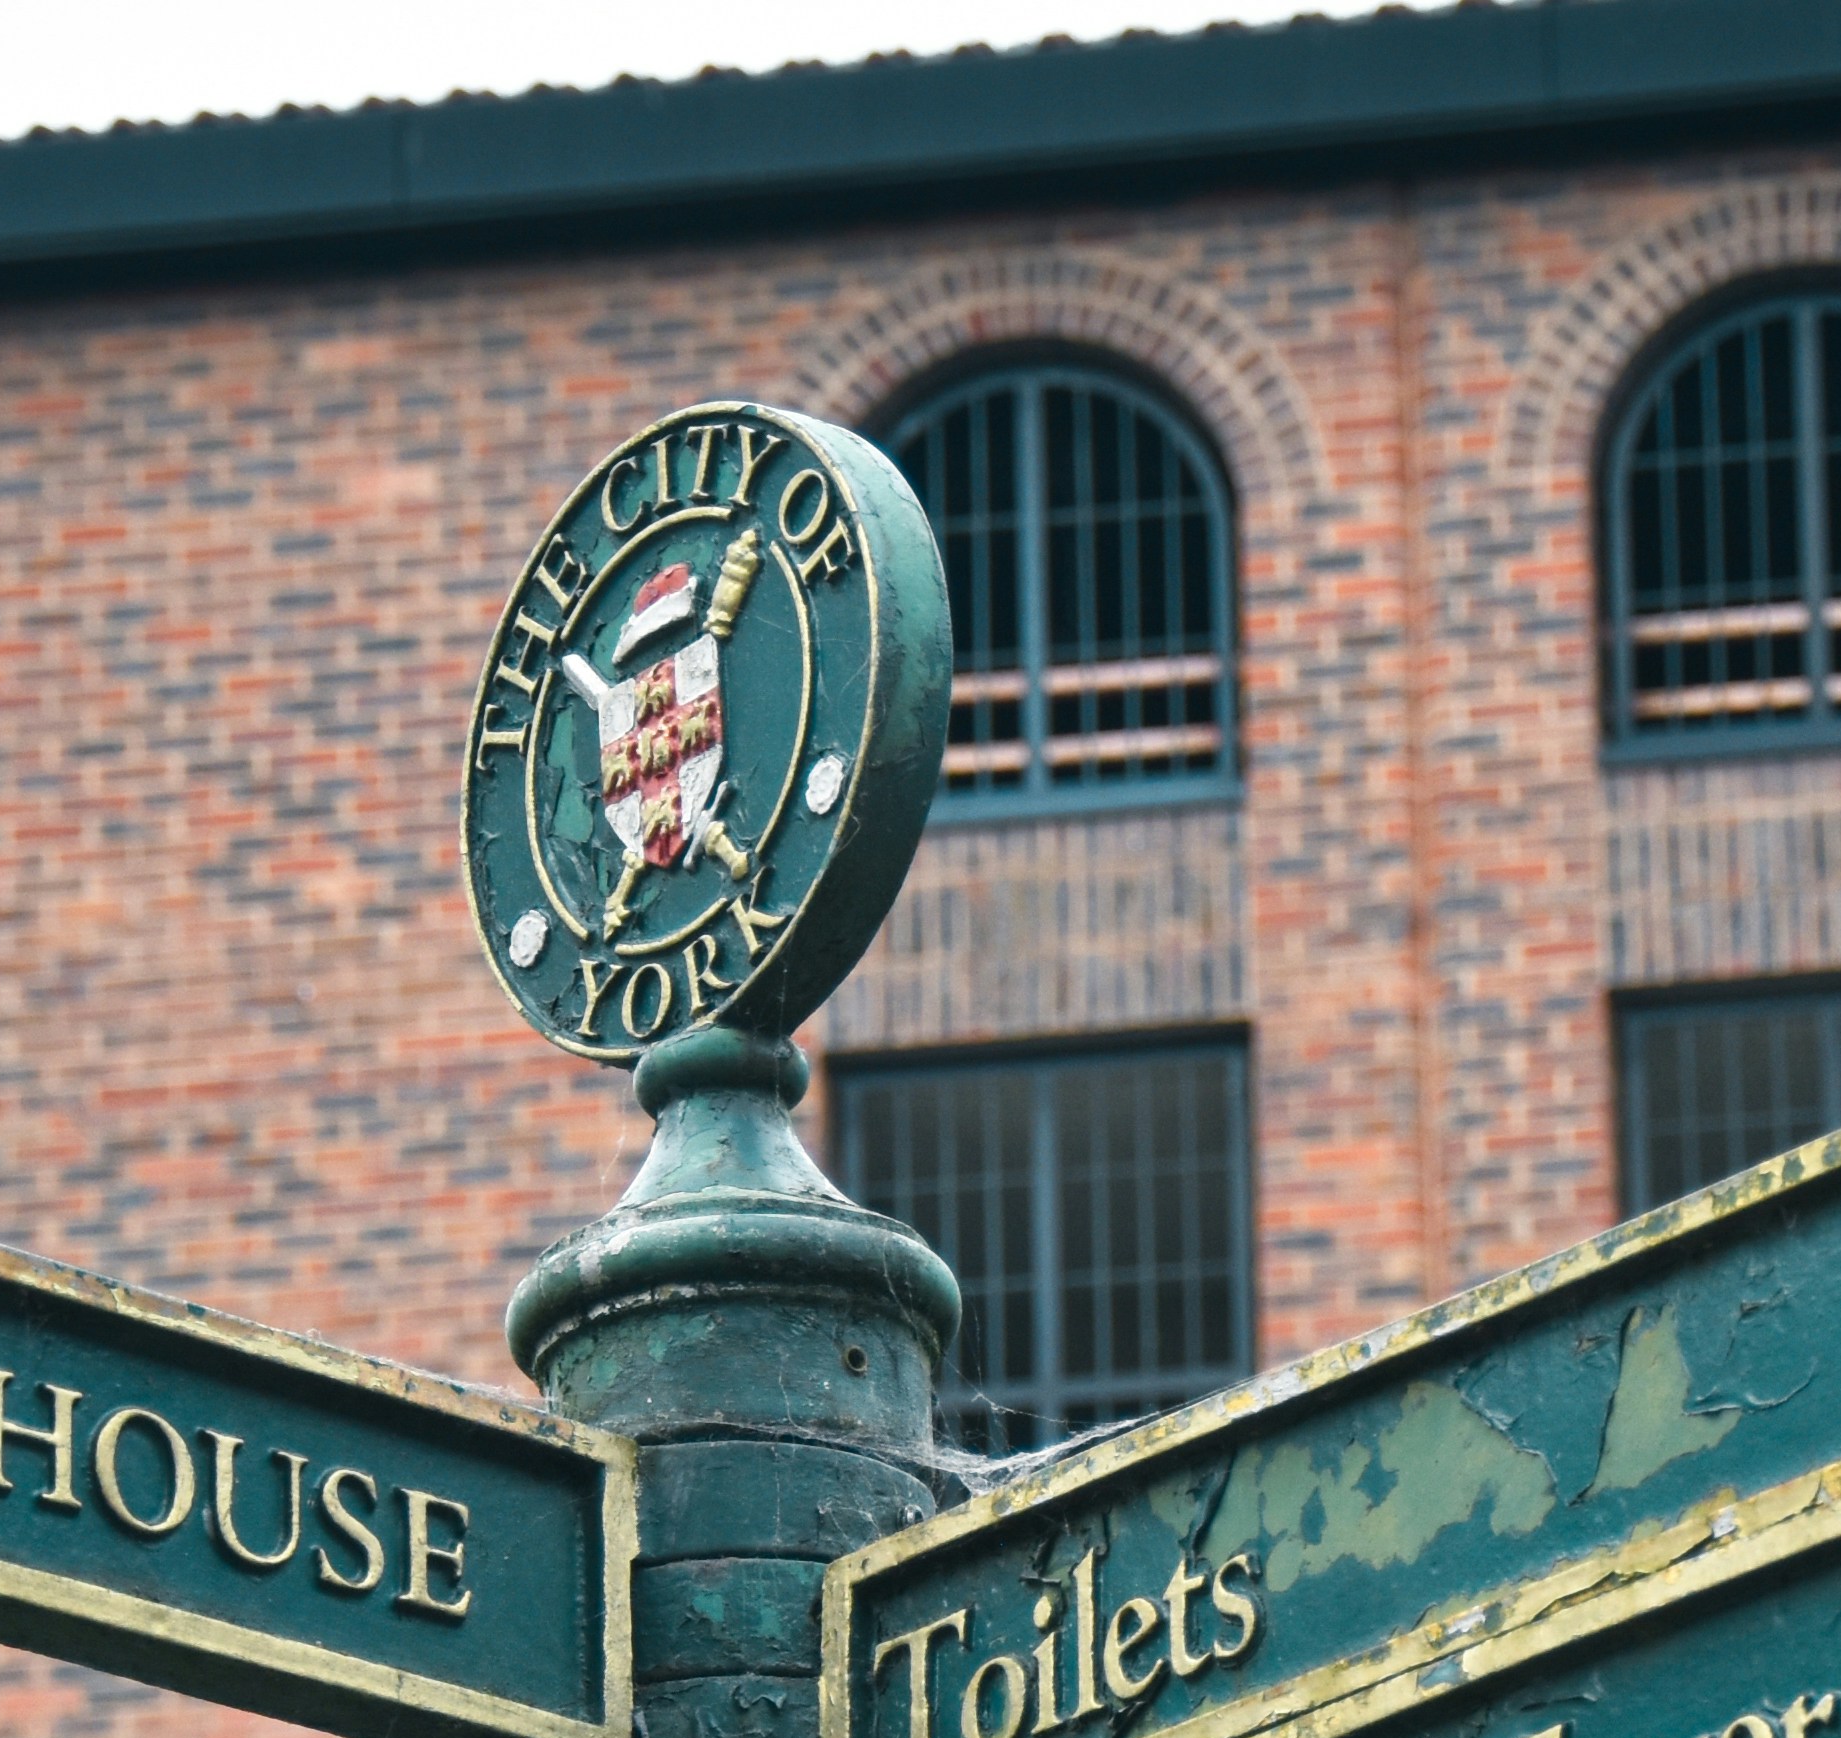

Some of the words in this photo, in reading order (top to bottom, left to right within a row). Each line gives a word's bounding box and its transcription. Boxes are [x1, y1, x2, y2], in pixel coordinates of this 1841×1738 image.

[476, 532, 593, 771] THE
[600, 424, 787, 533] CITY
[777, 467, 858, 585] OF
[577, 868, 792, 1040] YORK
